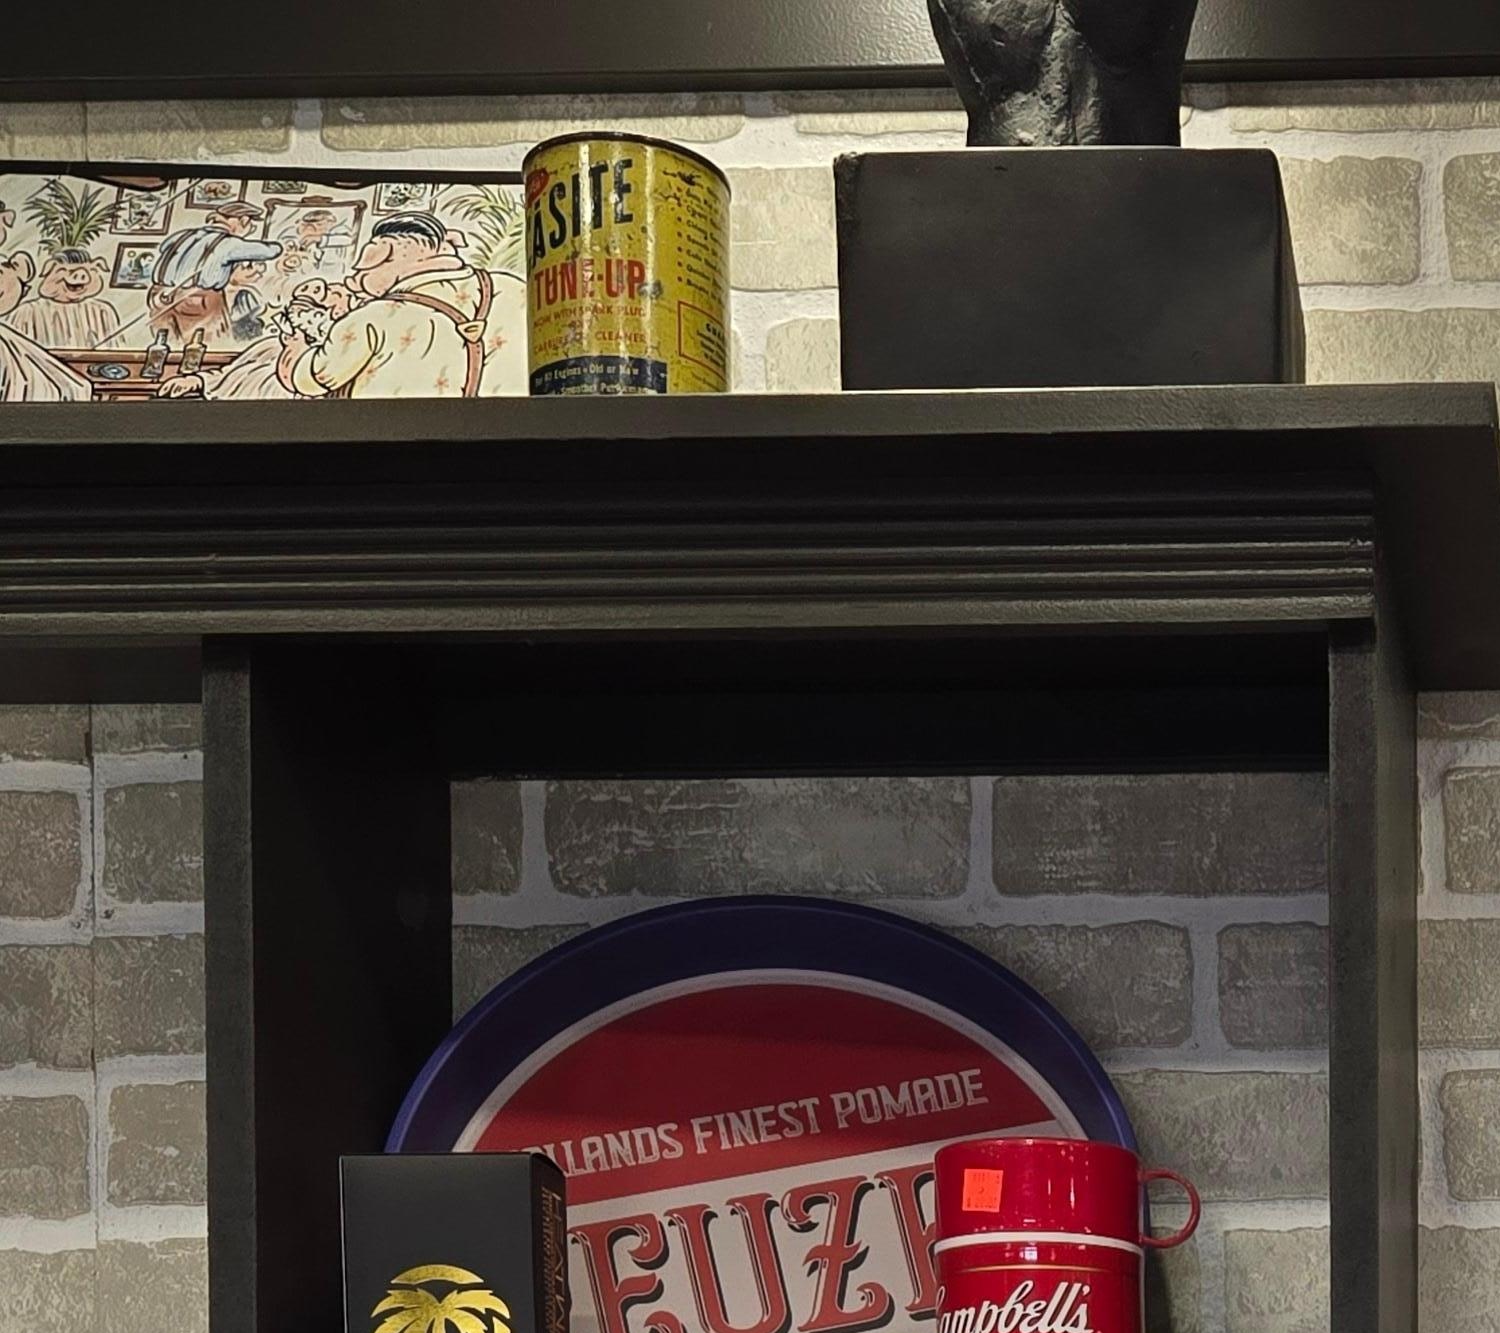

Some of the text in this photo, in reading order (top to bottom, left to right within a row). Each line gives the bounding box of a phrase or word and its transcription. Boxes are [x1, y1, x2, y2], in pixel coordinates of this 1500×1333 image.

[530, 158, 634, 266] ASITE
[534, 257, 646, 311] TUNE-UP
[595, 331, 647, 343] CLEANER
[589, 362, 604, 374] Old
[530, 1068, 989, 1177] LLANDS FINEST POMADE
